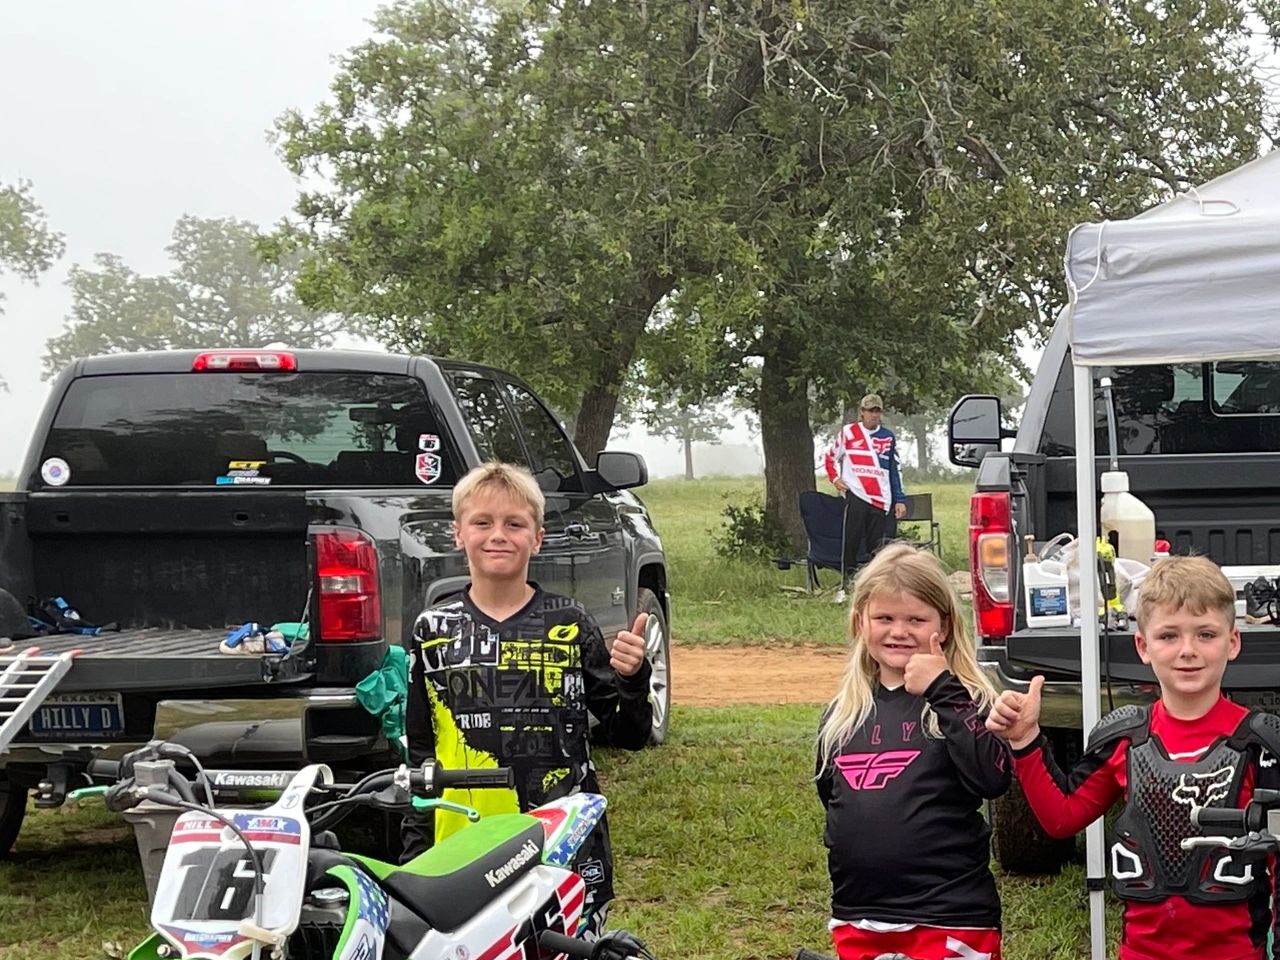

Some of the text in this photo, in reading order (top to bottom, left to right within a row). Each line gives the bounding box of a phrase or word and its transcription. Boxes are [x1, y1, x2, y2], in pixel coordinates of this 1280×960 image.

[852, 467, 885, 477] HONDA
[41, 708, 111, 729] HILLY D
[214, 772, 284, 787] Kawasaki
[184, 820, 212, 829] HILL
[484, 839, 540, 888] Kawasaki
[171, 847, 282, 922] 16
